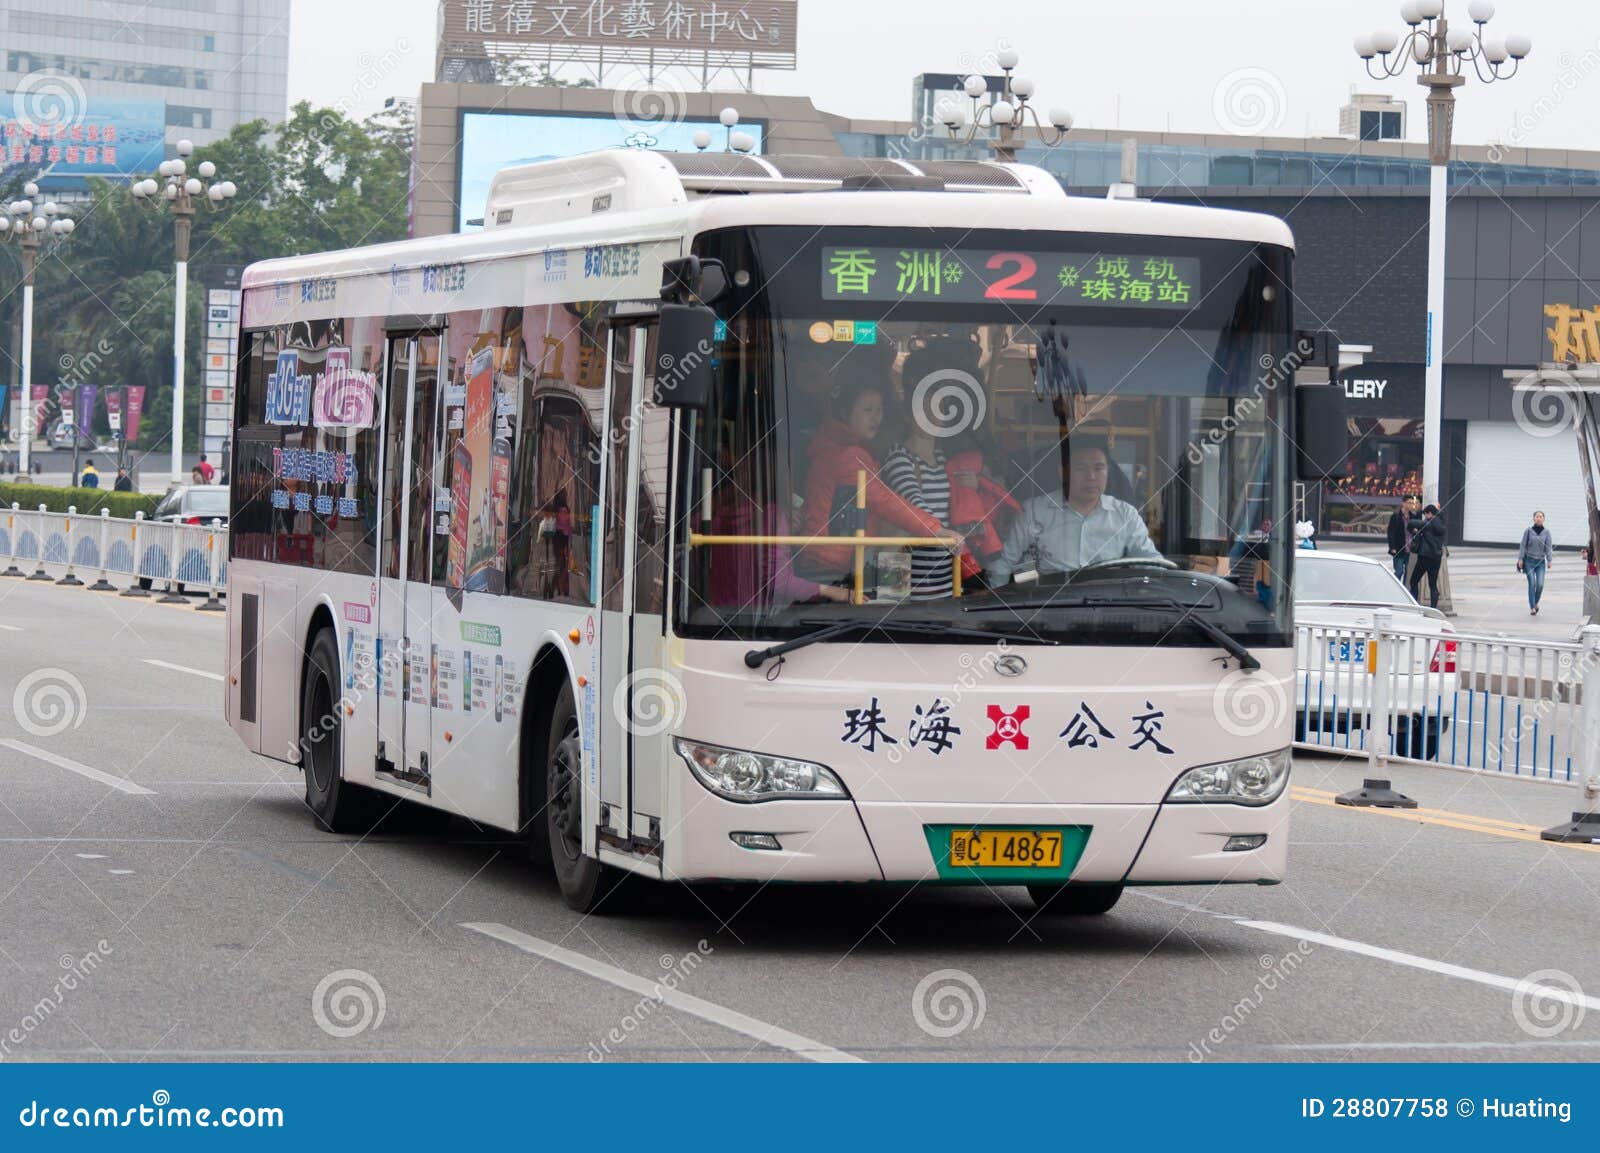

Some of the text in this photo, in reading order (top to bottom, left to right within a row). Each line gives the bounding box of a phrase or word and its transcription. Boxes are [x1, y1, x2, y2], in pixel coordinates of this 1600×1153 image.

[465, 0, 765, 43] 龍禧文化藝術中心
[829, 249, 942, 295] 香洲
[984, 252, 1037, 299] 2
[1081, 279, 1191, 303] 珠海站
[1095, 257, 1178, 281] 城轨
[1337, 379, 1388, 399] LERY
[841, 697, 961, 755] 珠海
[1059, 701, 1175, 755] 公交
